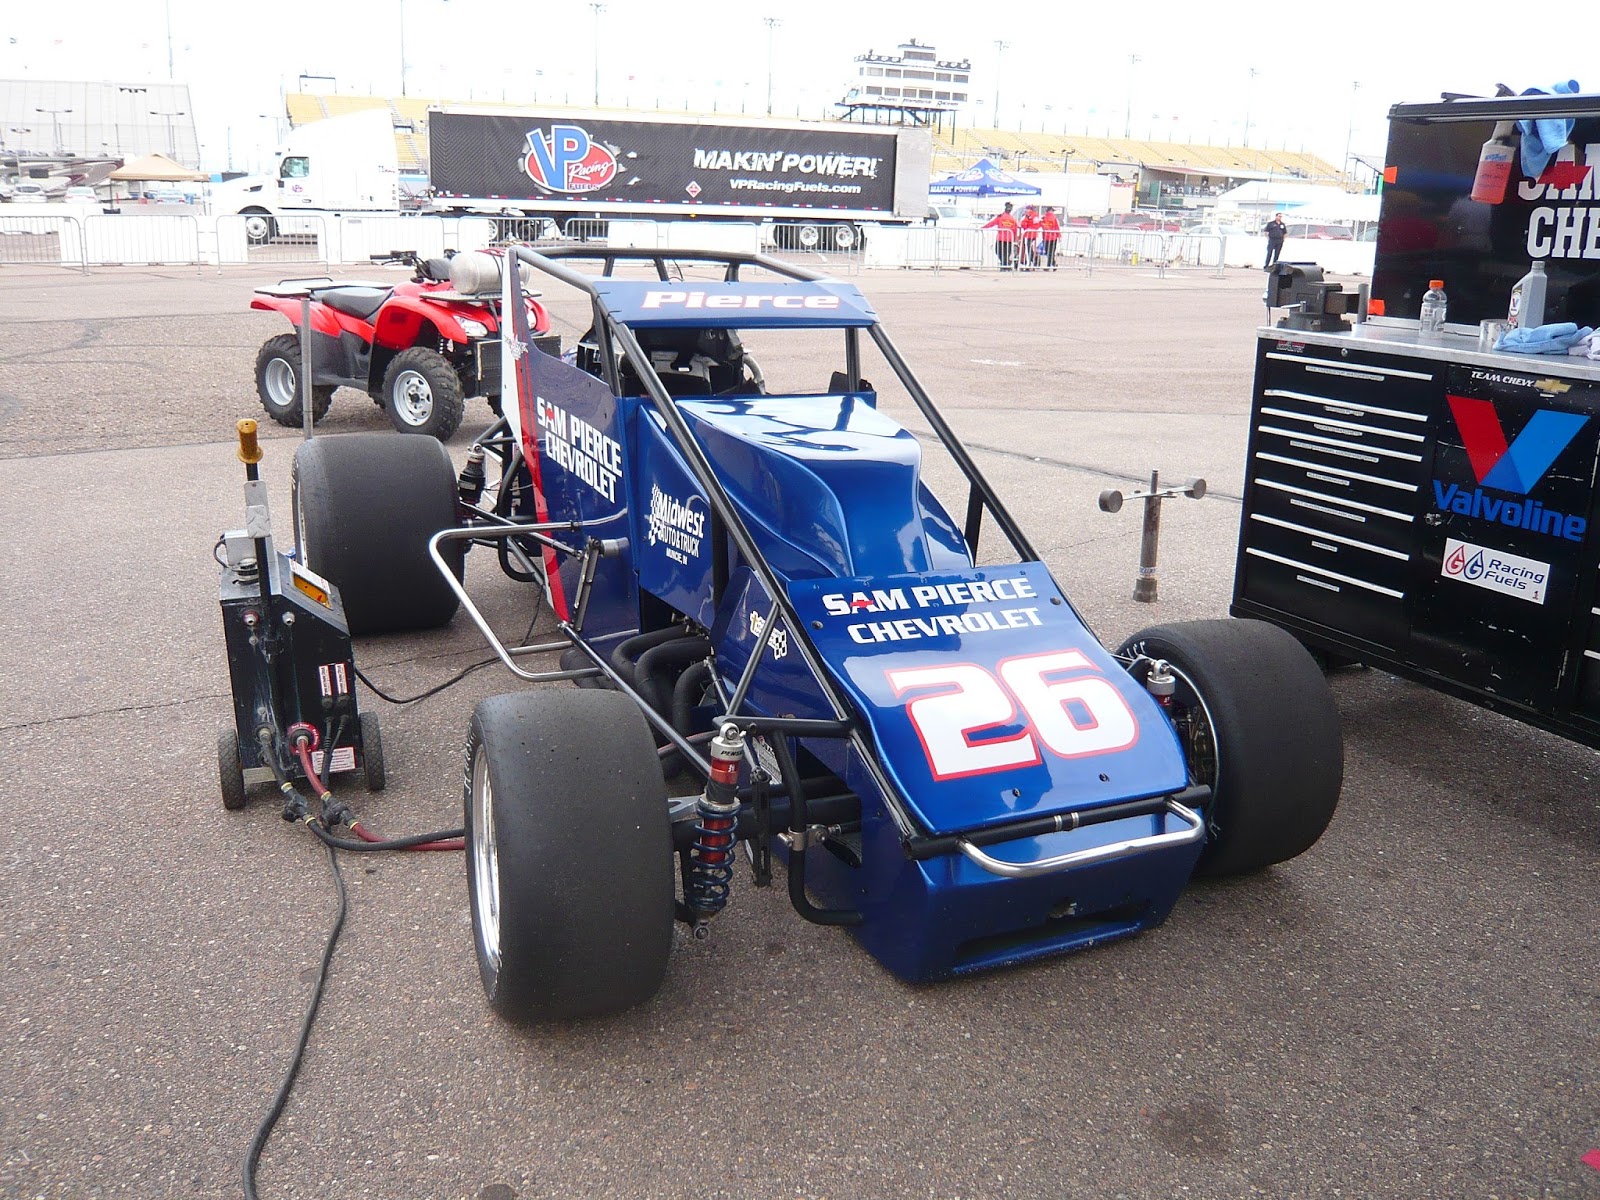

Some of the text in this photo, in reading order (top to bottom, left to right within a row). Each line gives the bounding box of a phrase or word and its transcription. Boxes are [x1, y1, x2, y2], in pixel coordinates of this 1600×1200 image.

[525, 124, 590, 192] VP
[568, 160, 615, 183] Racing
[693, 149, 879, 177] MAKIN' POWER!
[569, 183, 600, 191] FUELS
[730, 178, 862, 194] VPRacingFuels.com
[640, 291, 840, 310] Pierce
[1471, 370, 1535, 387] TEAM CHEVY
[536, 396, 623, 477] SAM PIERCE
[545, 430, 617, 504] CHEVROLET
[656, 492, 704, 538] Midwest
[1432, 480, 1587, 543] Valvoline
[1484, 570, 1528, 591] Fuels
[1488, 558, 1545, 585] Racing
[821, 577, 1038, 617] SAM PIERCE
[846, 606, 1044, 645] CHEVROLET
[884, 647, 1140, 782] 26
